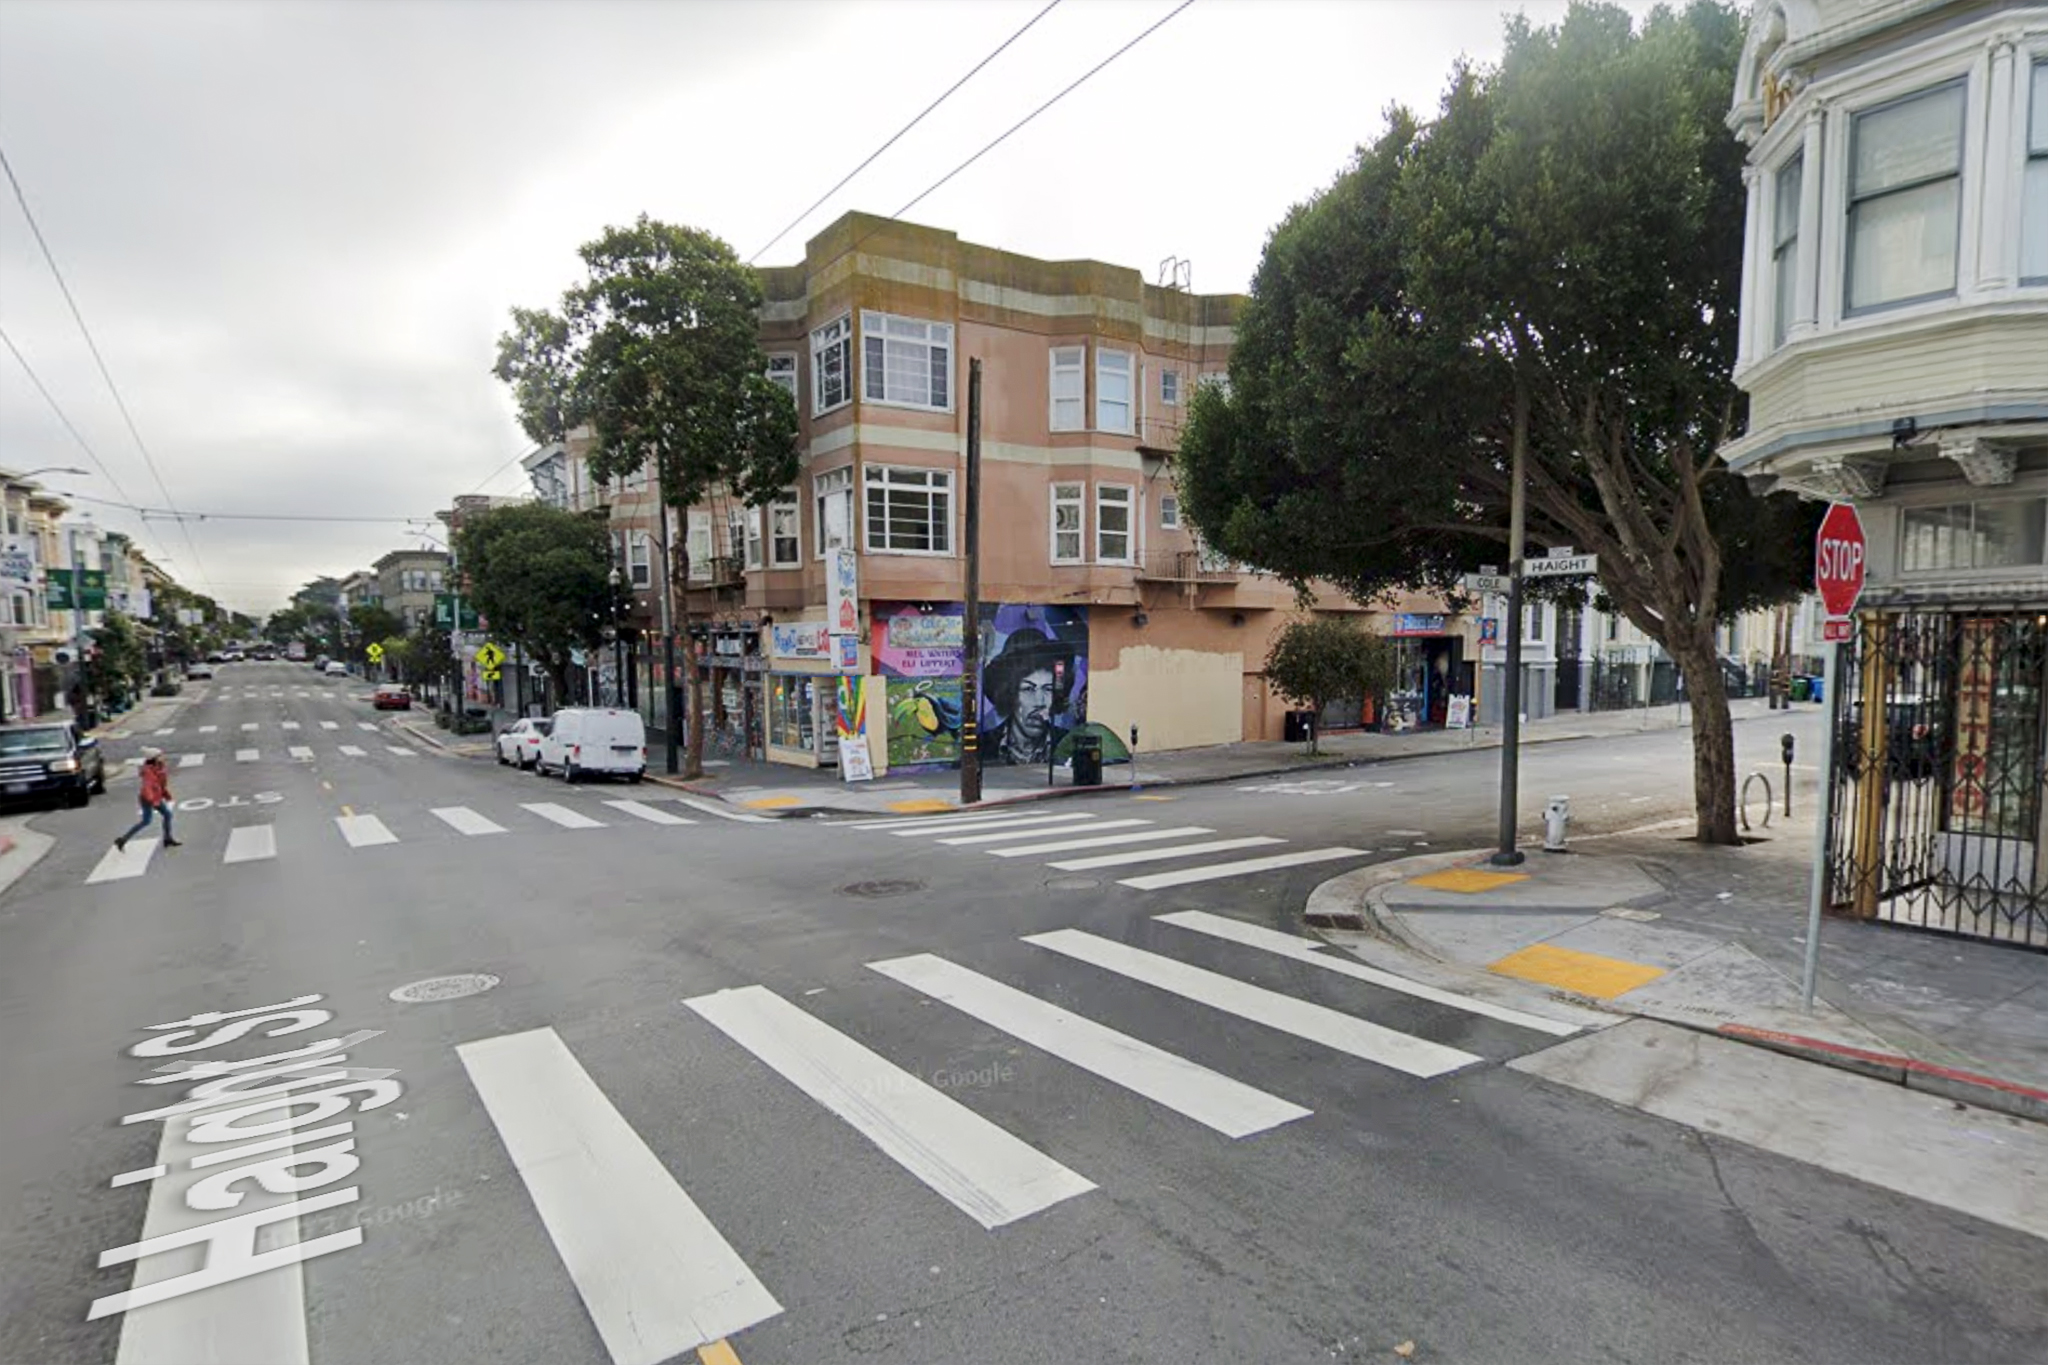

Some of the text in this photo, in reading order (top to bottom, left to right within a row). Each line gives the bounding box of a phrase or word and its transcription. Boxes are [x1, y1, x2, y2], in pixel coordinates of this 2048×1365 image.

[1531, 558, 1589, 572] HAIGHT
[1820, 538, 1862, 580] STOP
[1477, 577, 1500, 589] COLE
